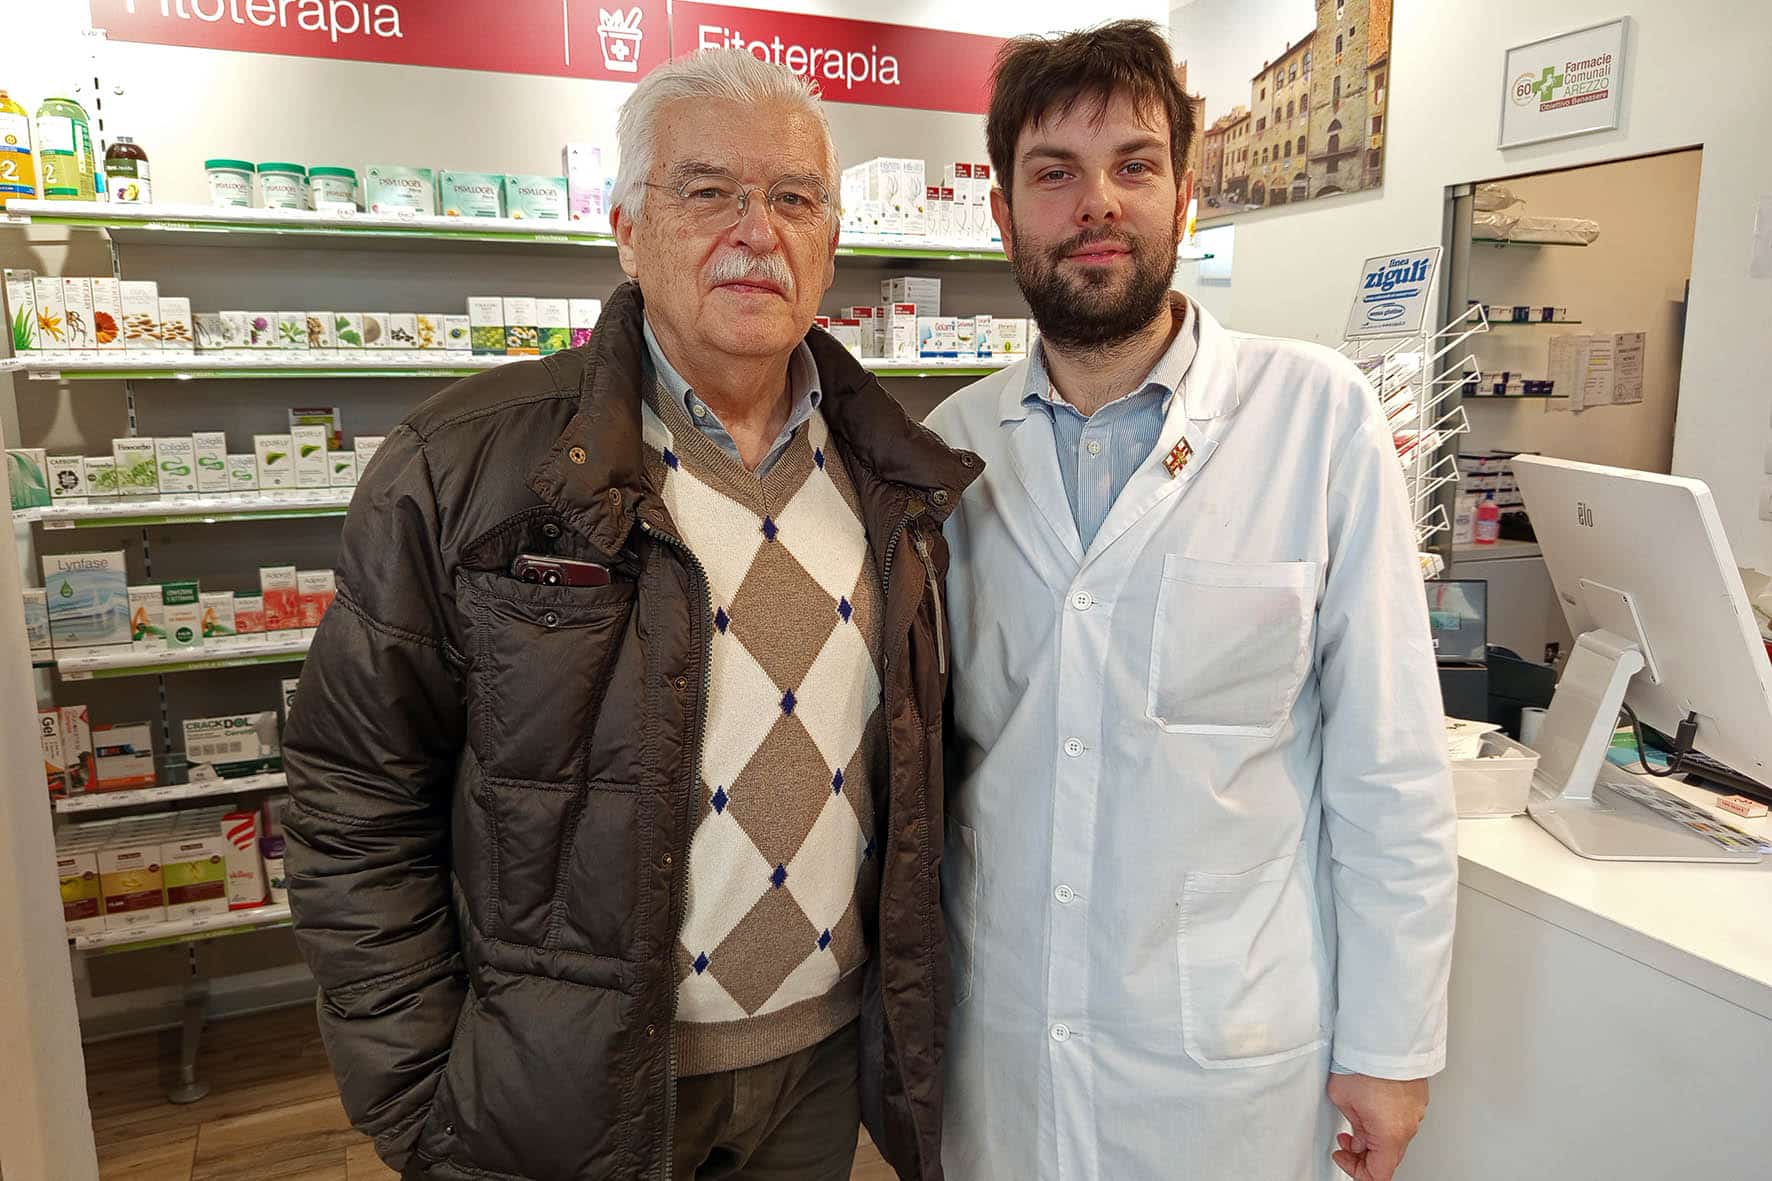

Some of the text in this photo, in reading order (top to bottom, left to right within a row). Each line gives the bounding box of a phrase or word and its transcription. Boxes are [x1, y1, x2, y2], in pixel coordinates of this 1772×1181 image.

[1565, 53, 1612, 73] Farmacie
[1564, 64, 1611, 85] Comunali
[1516, 83, 1531, 97] 60
[1563, 78, 1609, 97] AREZZO
[1, 160, 19, 181] 2
[44, 164, 57, 184] 2
[57, 558, 109, 571] Lynfase
[42, 716, 57, 738] Gel
